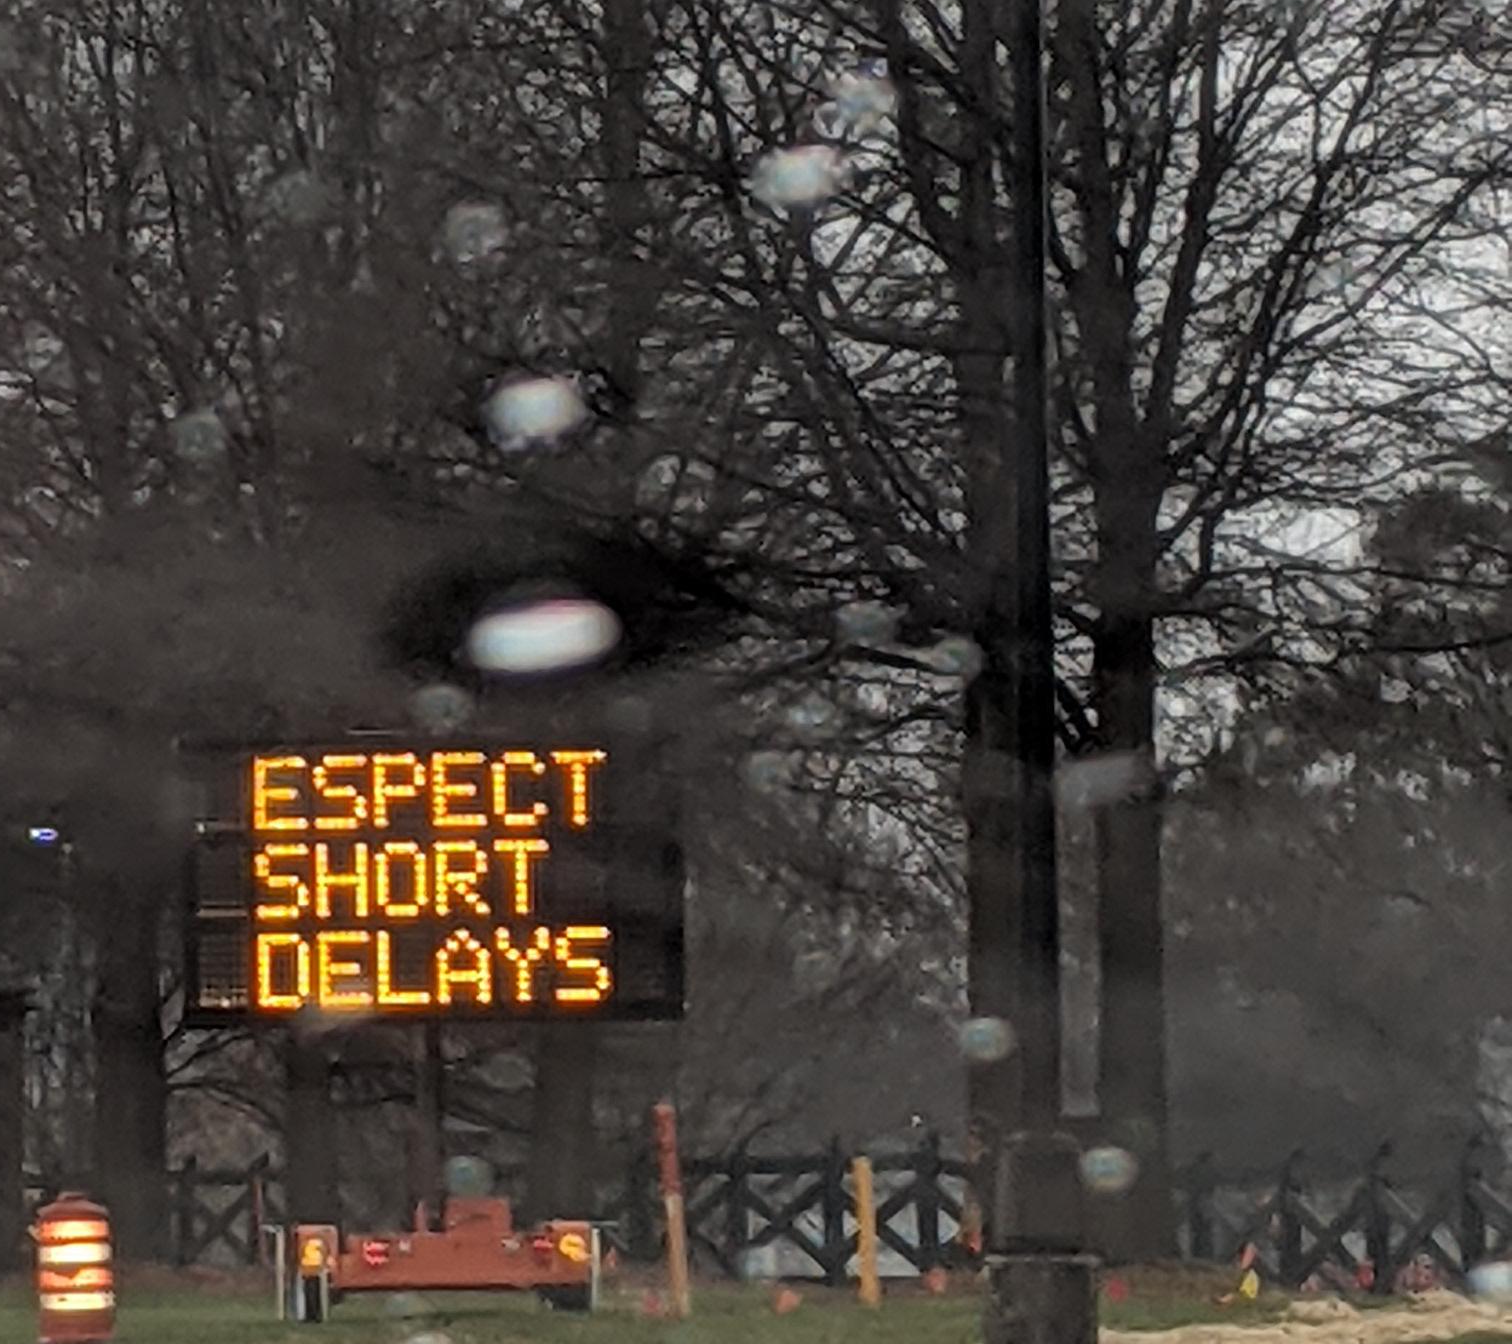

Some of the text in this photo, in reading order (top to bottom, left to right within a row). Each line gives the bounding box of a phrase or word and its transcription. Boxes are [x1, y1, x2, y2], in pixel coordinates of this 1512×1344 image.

[253, 750, 607, 830] ESPECT
[254, 838, 550, 920] SHORT
[256, 926, 610, 1010] DELAYS
